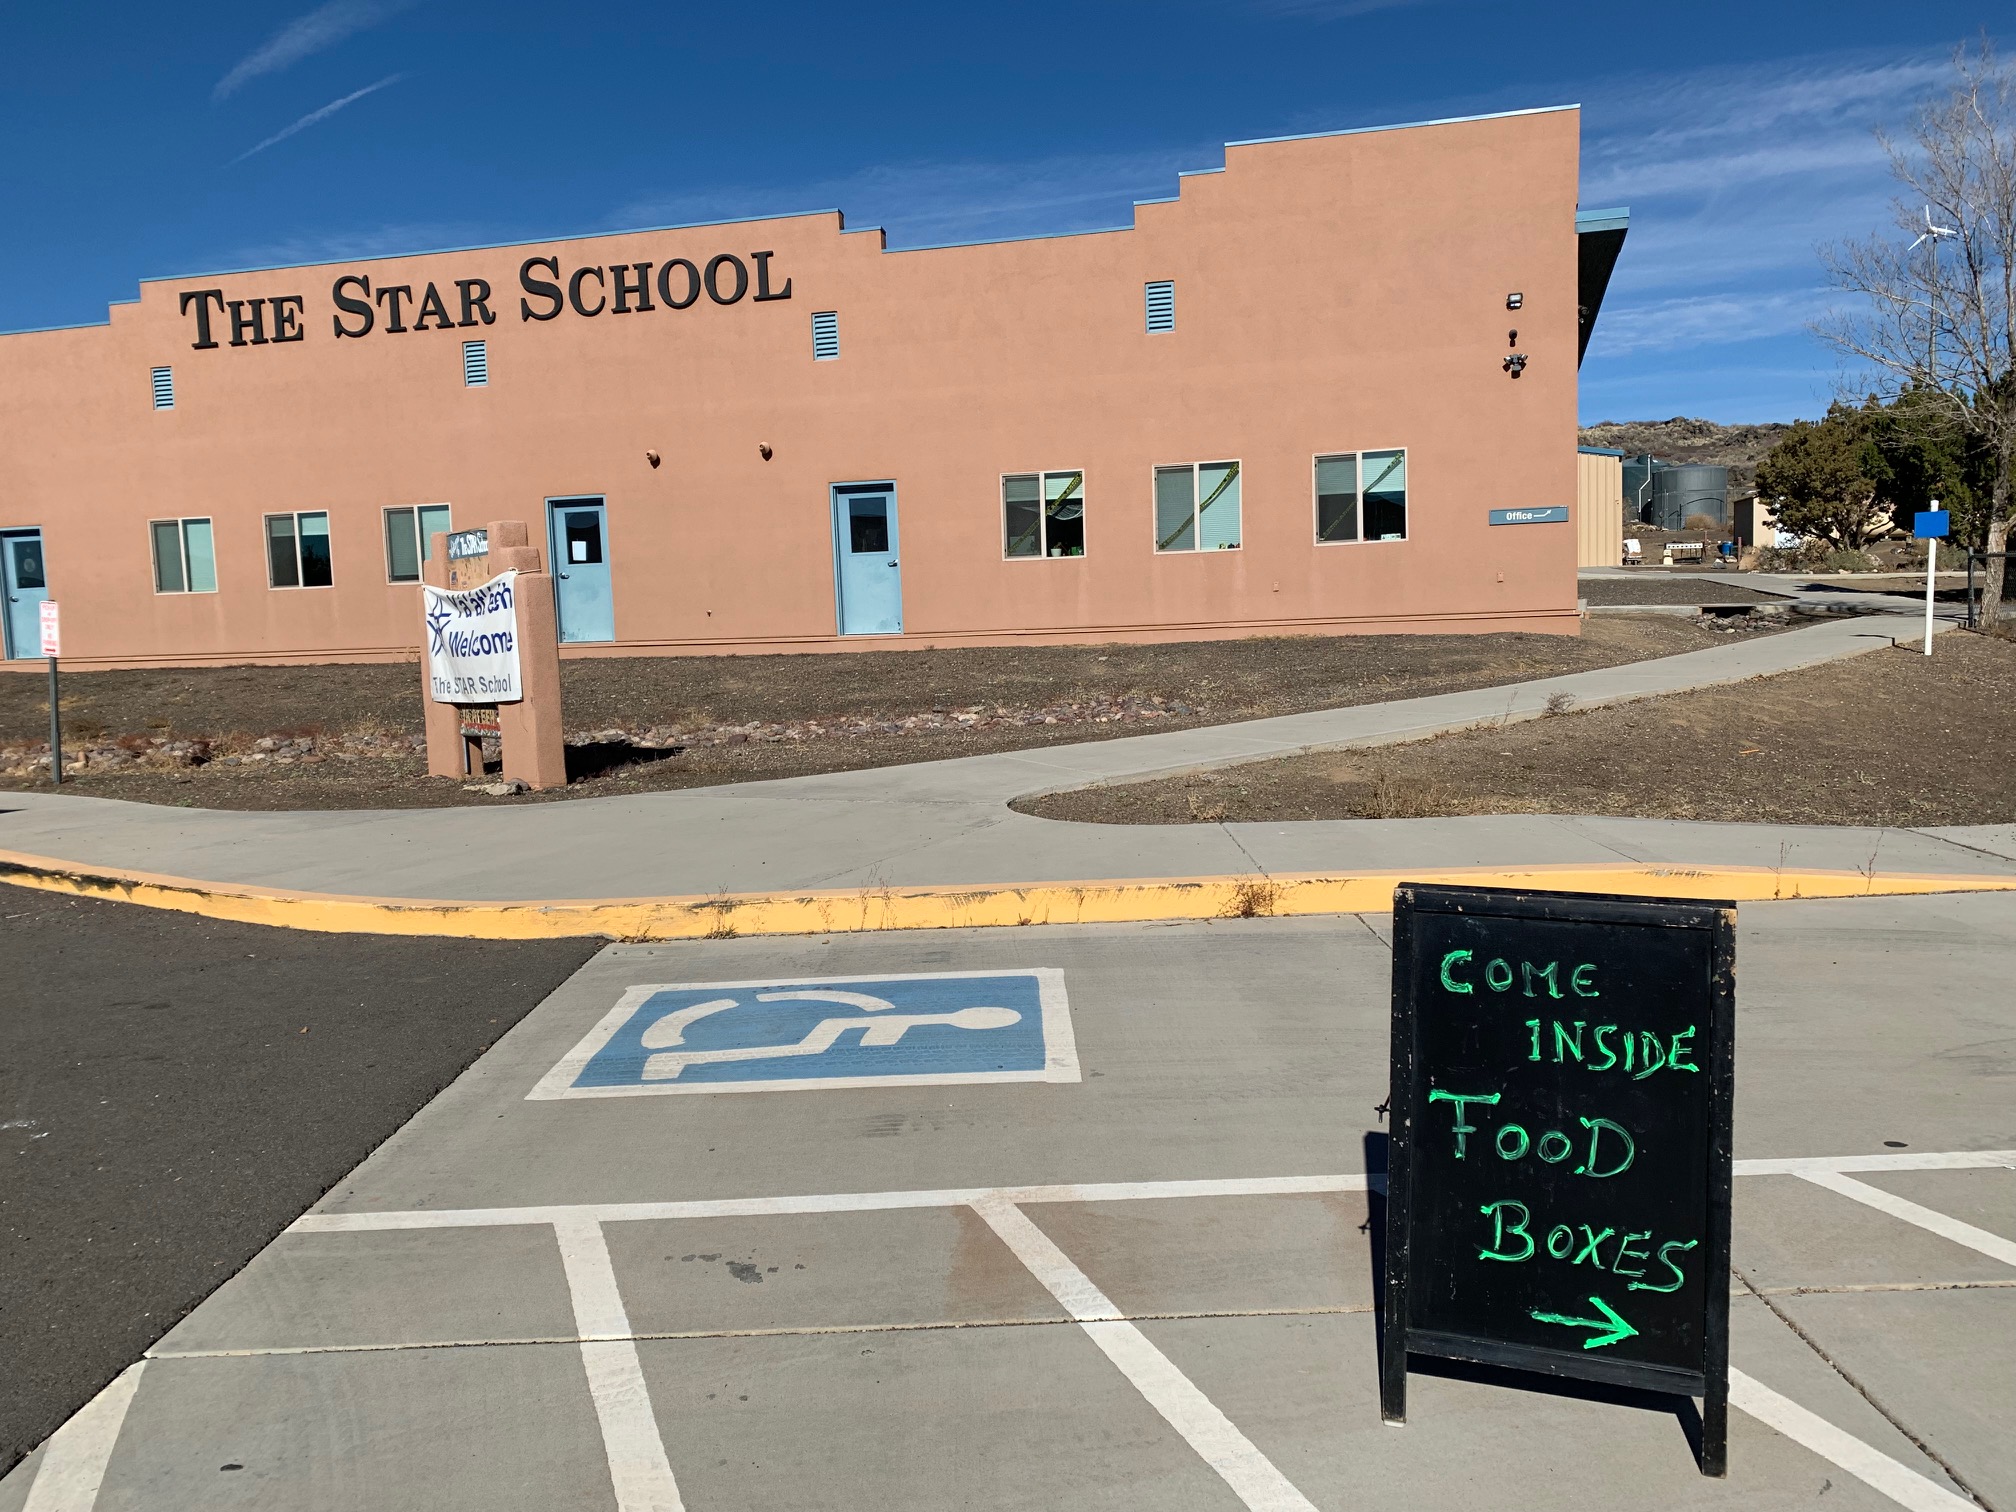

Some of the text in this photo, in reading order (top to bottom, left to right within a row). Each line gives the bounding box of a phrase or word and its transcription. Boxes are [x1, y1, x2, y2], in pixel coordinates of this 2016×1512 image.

[180, 250, 793, 350] THE STAR SCHOOL
[1506, 512, 1533, 521] Office
[448, 629, 513, 658] Welcome
[432, 673, 512, 695] The STAR School
[1440, 949, 1601, 999] COME
[1526, 1018, 1700, 1080] INSIDE
[1474, 1200, 1699, 1293] BOXES
